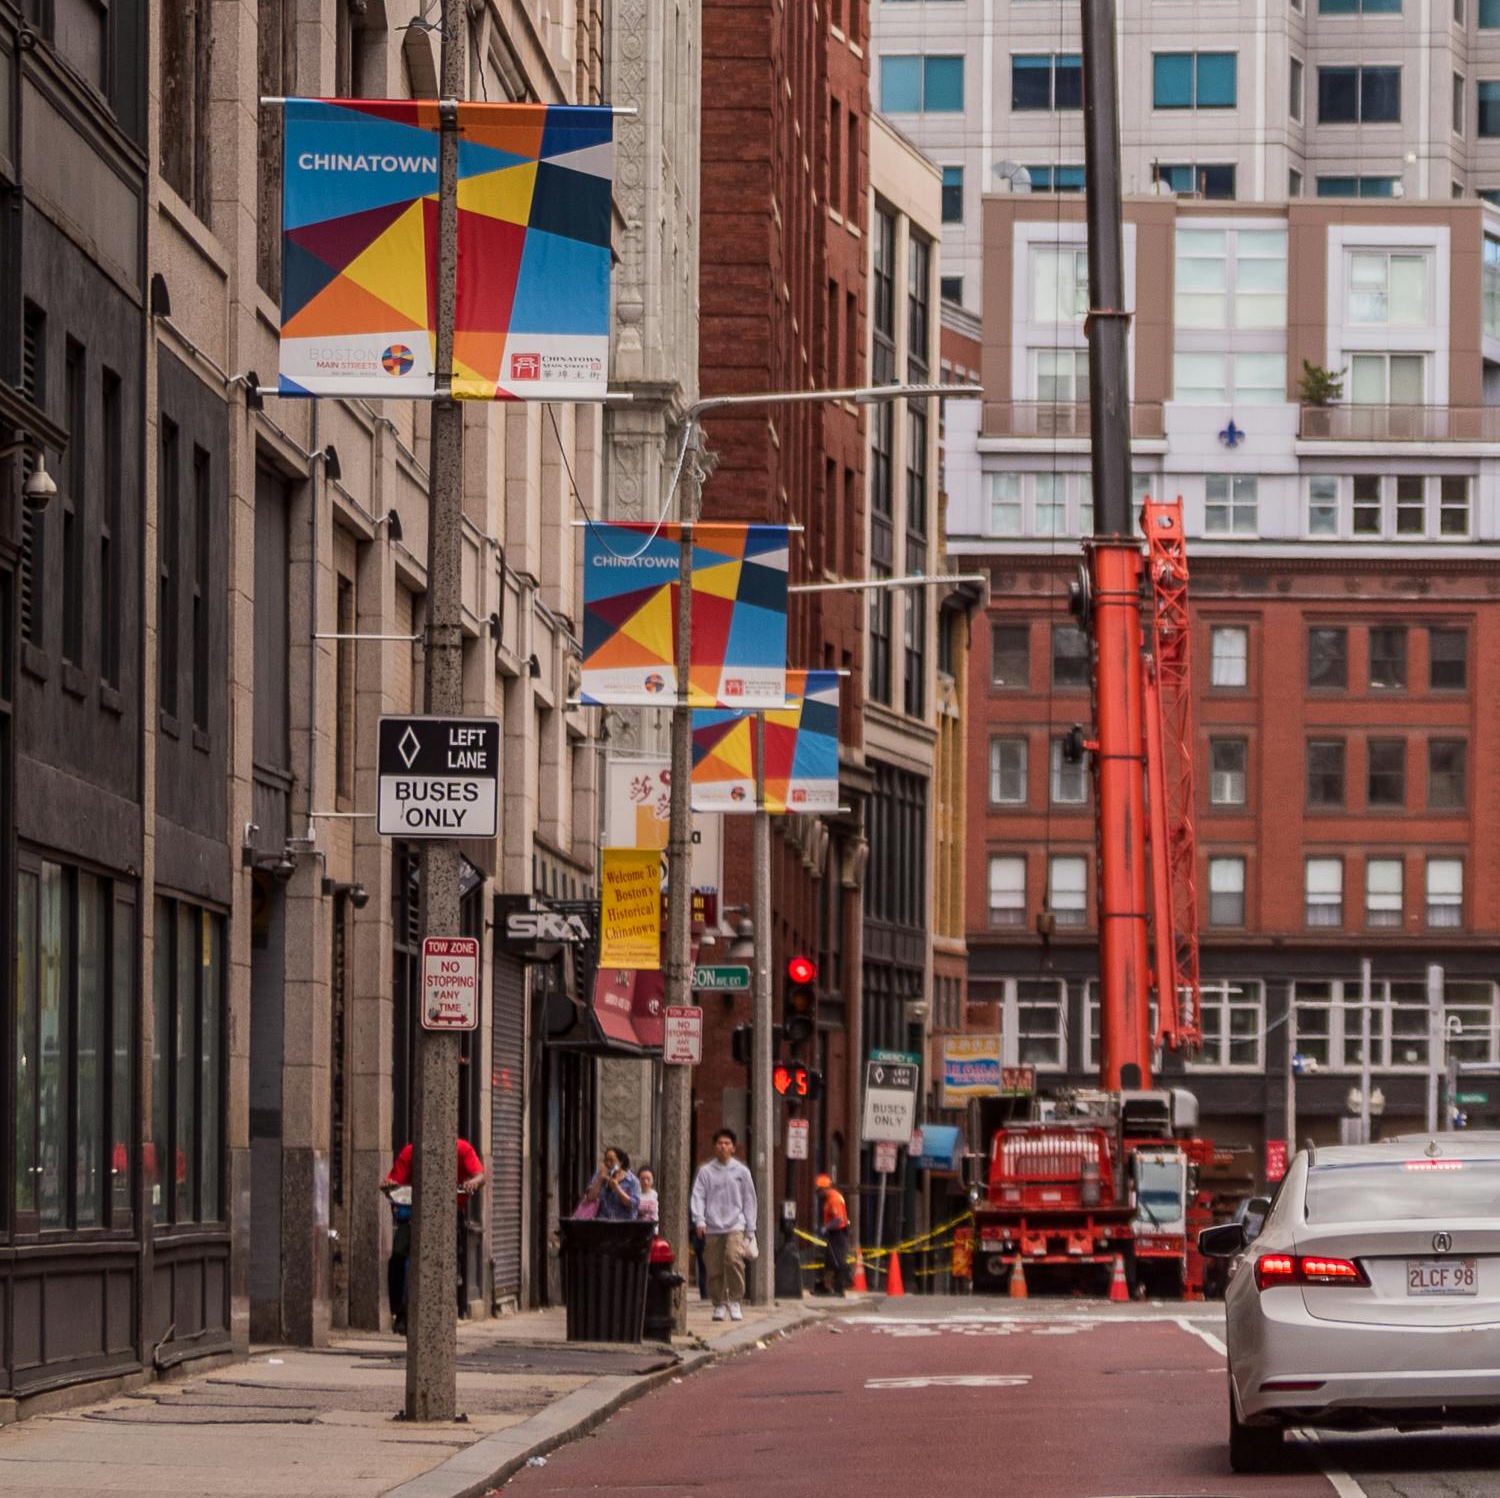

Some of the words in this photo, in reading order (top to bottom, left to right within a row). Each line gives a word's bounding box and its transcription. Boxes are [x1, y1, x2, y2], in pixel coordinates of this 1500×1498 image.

[299, 153, 438, 173] CHINATOWN
[309, 348, 378, 361] BOSTON
[317, 361, 339, 369] MAIN
[593, 555, 680, 569] CHINATOWN
[449, 728, 486, 746] LEFT
[447, 751, 487, 769] LANE
[395, 781, 479, 802] BUSES
[406, 808, 467, 828] ONLY
[607, 870, 644, 884] Welcome
[646, 865, 657, 878] To
[615, 886, 653, 902] Boston's
[607, 902, 655, 922] Historical
[605, 924, 655, 941] Chinatown
[428, 941, 448, 953] TOW
[450, 943, 474, 954] ZONE
[441, 961, 460, 973] NO
[426, 975, 474, 987] STOPPING
[440, 990, 460, 999] ANY
[439, 1003, 461, 1012] TIME
[678, 1020, 690, 1029] NO
[894, 1069, 910, 1077] LEFT
[795, 1070, 807, 1096] 5
[892, 1077, 910, 1085] LANE
[872, 1103, 907, 1115] BUSES
[874, 1115, 903, 1126] ONLY
[1410, 1269, 1449, 1288] 2LCF
[1454, 1269, 1474, 1287] 98
